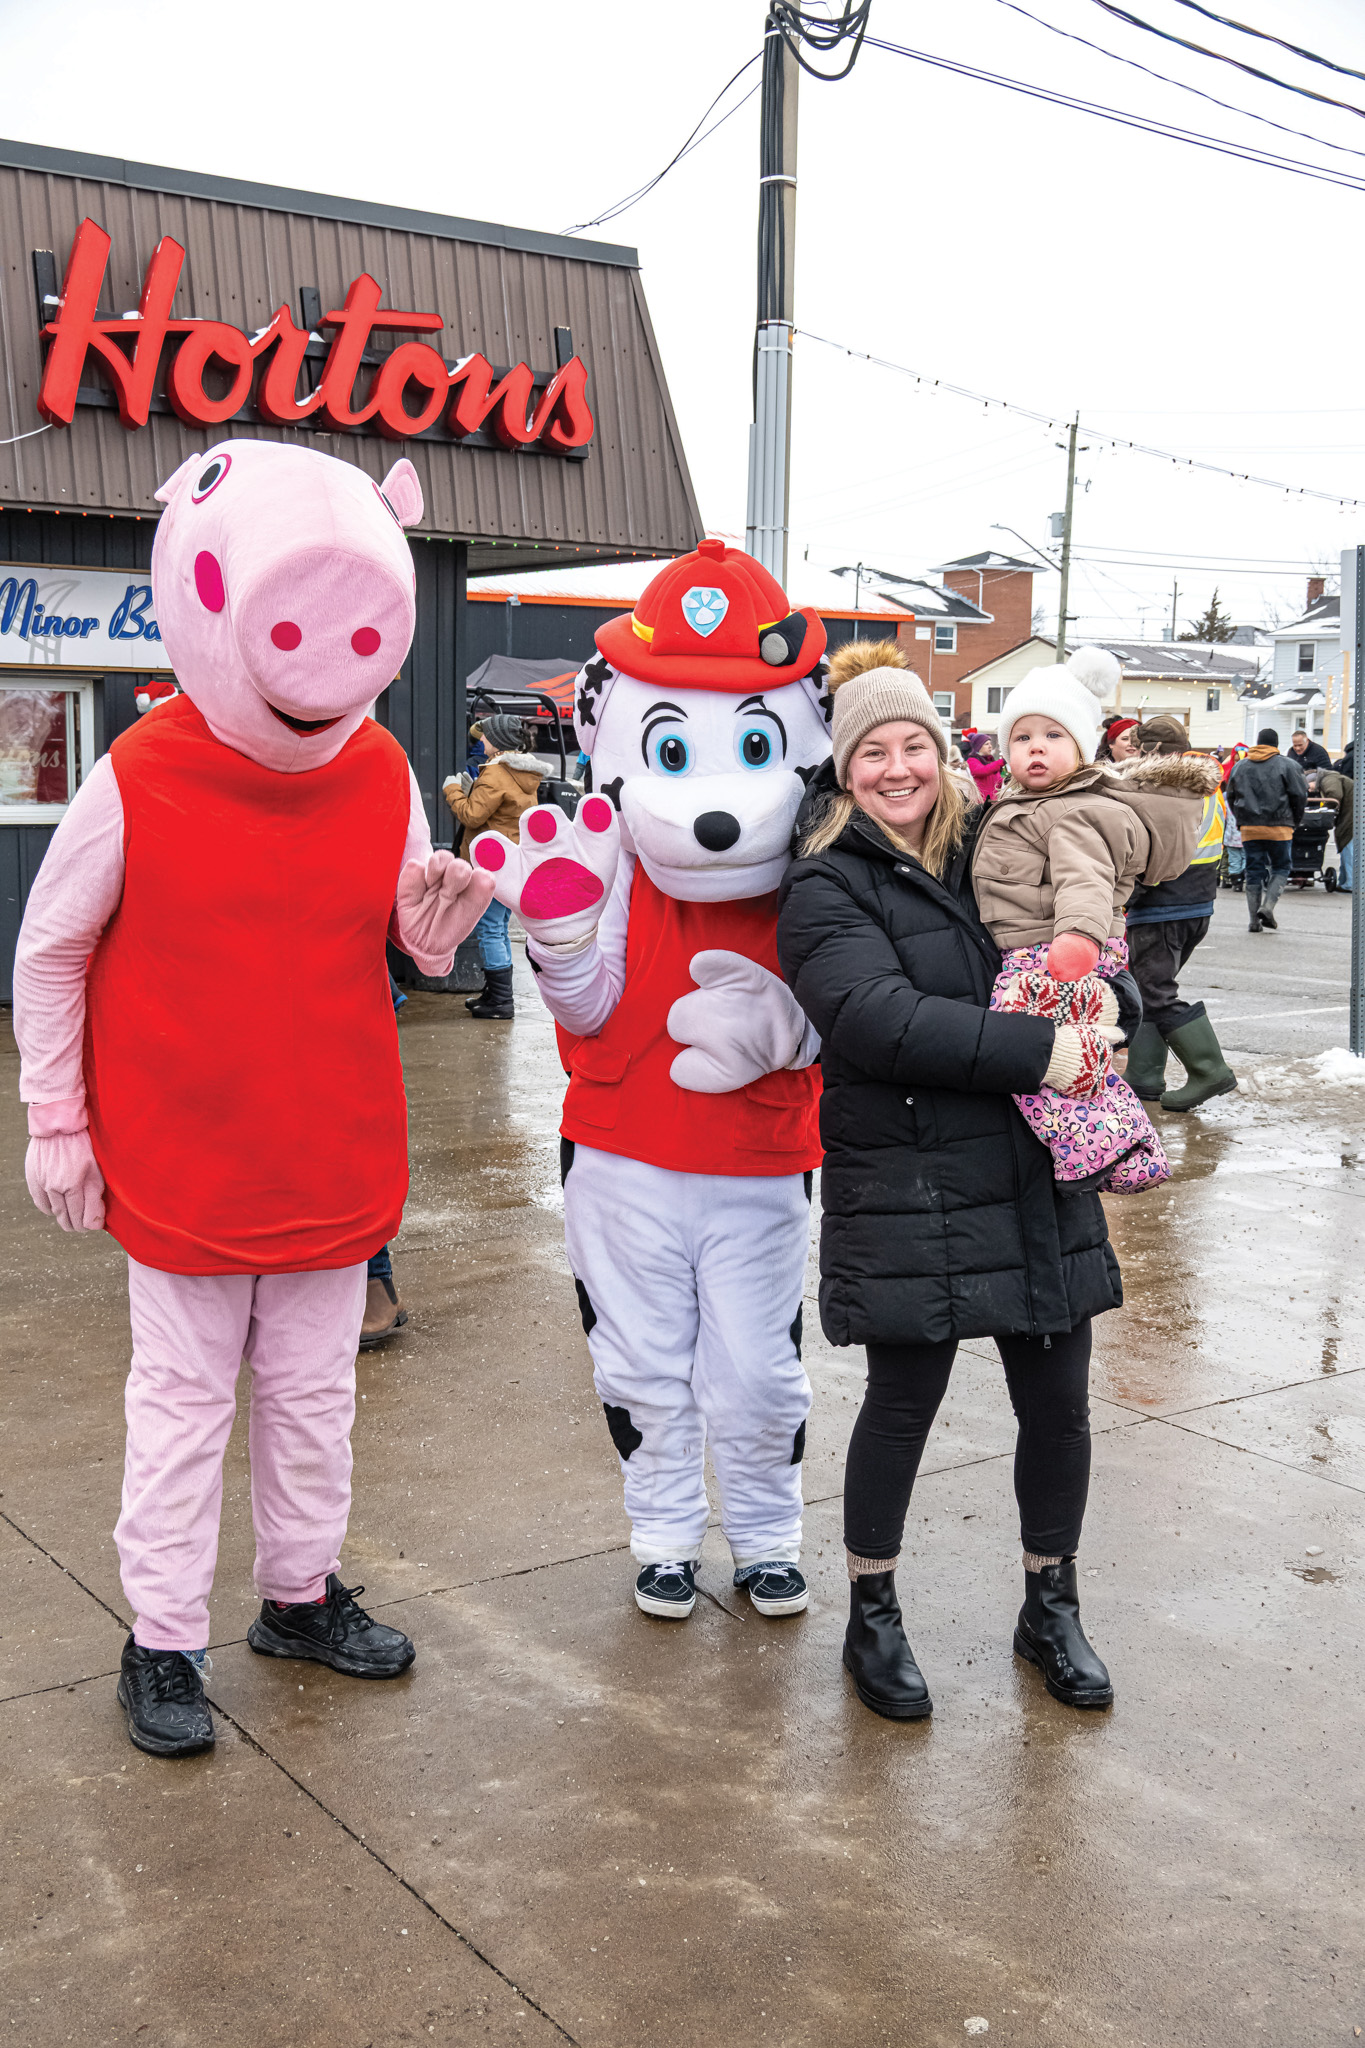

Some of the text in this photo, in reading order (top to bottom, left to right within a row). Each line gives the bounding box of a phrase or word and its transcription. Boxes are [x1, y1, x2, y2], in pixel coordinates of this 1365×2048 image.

[37, 217, 595, 451] Hortons
[0, 577, 162, 642] Minor Ba
